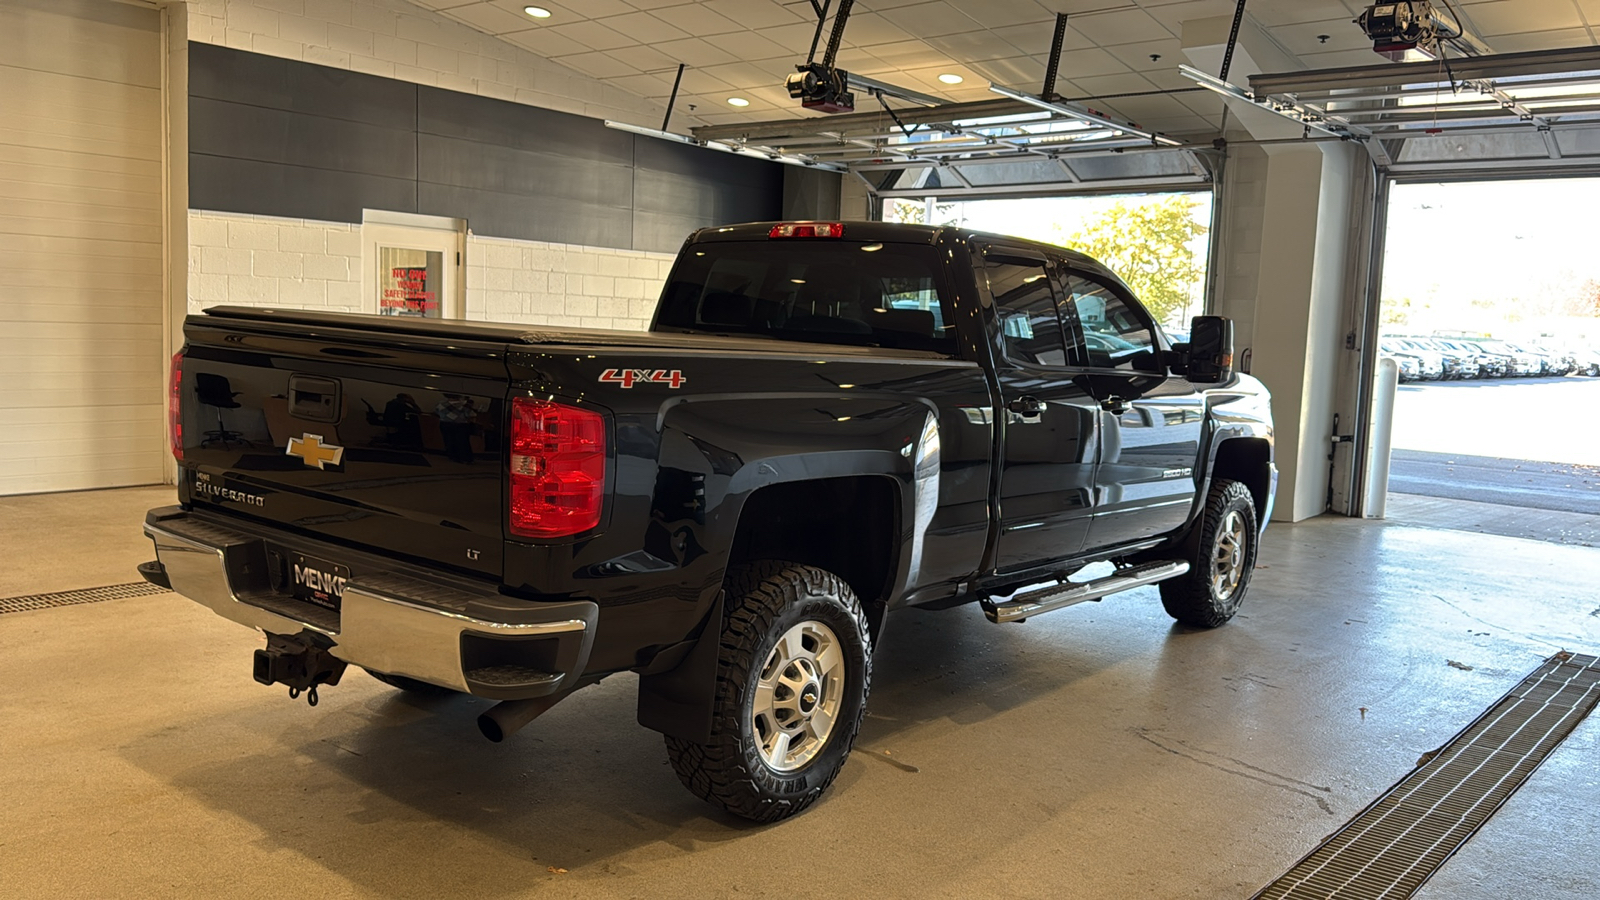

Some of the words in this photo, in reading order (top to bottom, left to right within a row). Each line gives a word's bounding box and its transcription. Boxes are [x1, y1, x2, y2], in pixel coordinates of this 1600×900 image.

[392, 269, 406, 279] NO
[409, 270, 427, 280] ONE
[397, 281, 424, 290] WITHOUT
[384, 289, 407, 299] SAFETY
[408, 291, 435, 300] GLASSES
[380, 299, 404, 308] BEYOND
[406, 300, 419, 309] THIS
[195, 481, 265, 507] SILVERADO
[467, 549, 481, 560] LT
[294, 563, 347, 597] MENKE
